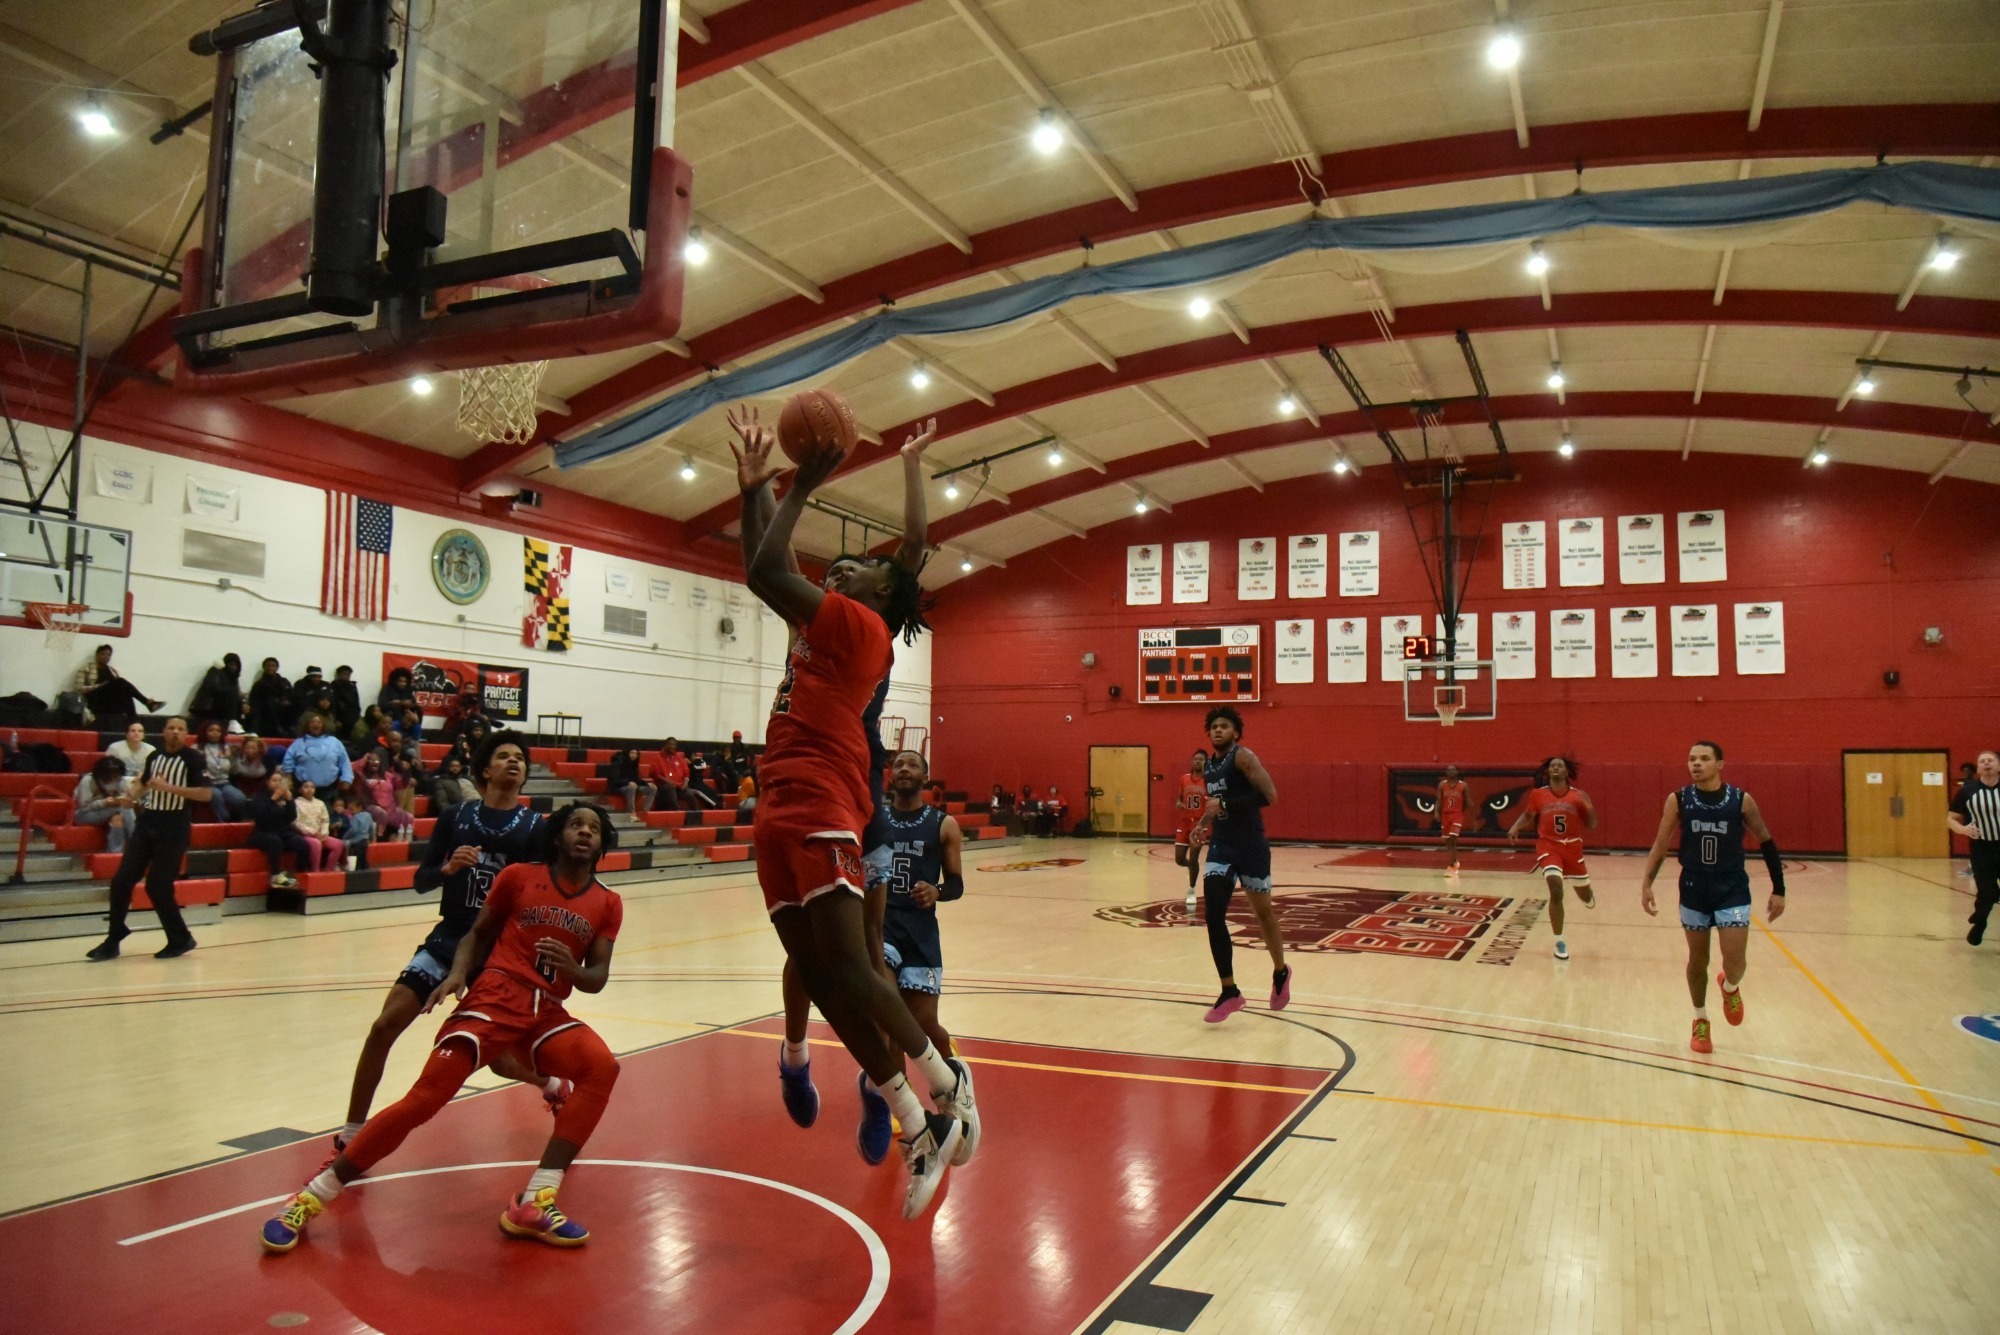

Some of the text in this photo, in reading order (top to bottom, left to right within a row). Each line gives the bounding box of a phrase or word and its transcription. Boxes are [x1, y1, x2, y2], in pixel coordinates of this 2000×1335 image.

[1143, 631, 1172, 639] BCCC
[1142, 649, 1177, 658] PANTHERS
[1227, 647, 1250, 655] GUEST
[1405, 638, 1429, 657] 27
[484, 685, 522, 700] PROTECT
[485, 698, 498, 709] THIS
[1186, 794, 1201, 810] 15
[1553, 814, 1567, 835] 5
[1691, 819, 1729, 835] OWLS
[893, 840, 925, 857] WLS
[1701, 835, 1718, 865] 0
[892, 857, 911, 893] 5
